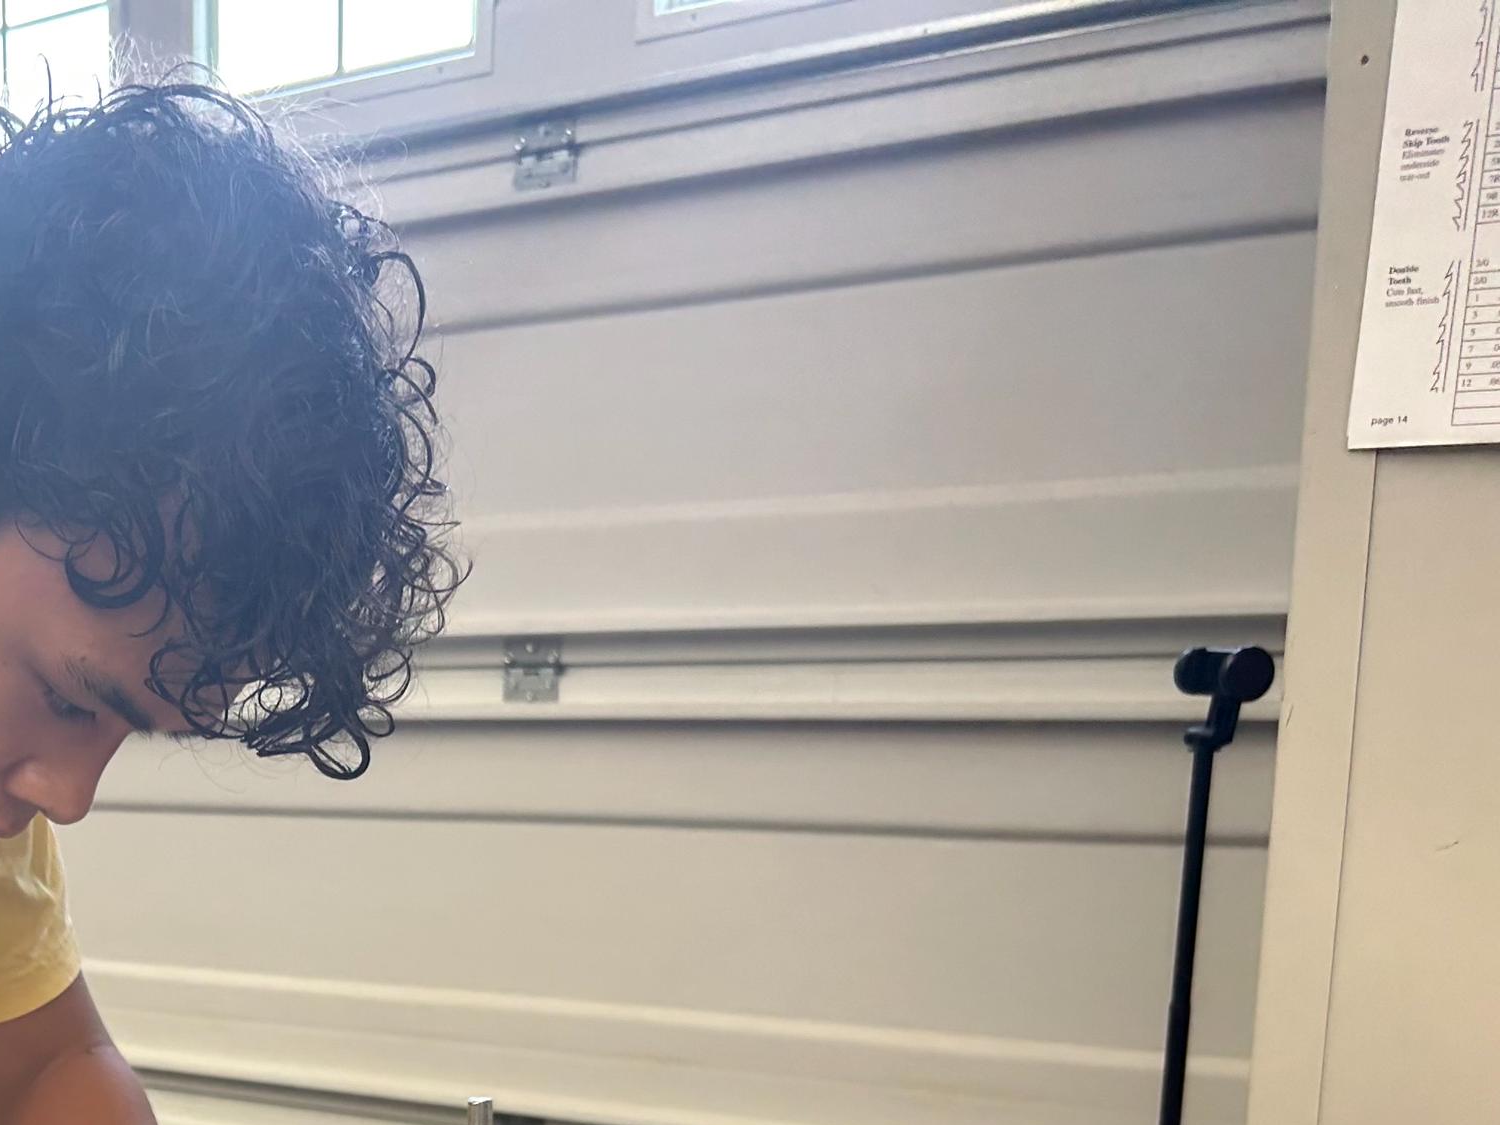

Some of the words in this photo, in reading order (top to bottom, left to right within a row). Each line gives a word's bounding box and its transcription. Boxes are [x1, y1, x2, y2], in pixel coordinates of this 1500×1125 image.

[1403, 140, 1423, 149] Skip
[1389, 265, 1420, 275] Double
[1388, 277, 1412, 286] Tooth
[1461, 378, 1472, 387] 12
[1371, 417, 1394, 427] page
[1397, 415, 1408, 424] 14
